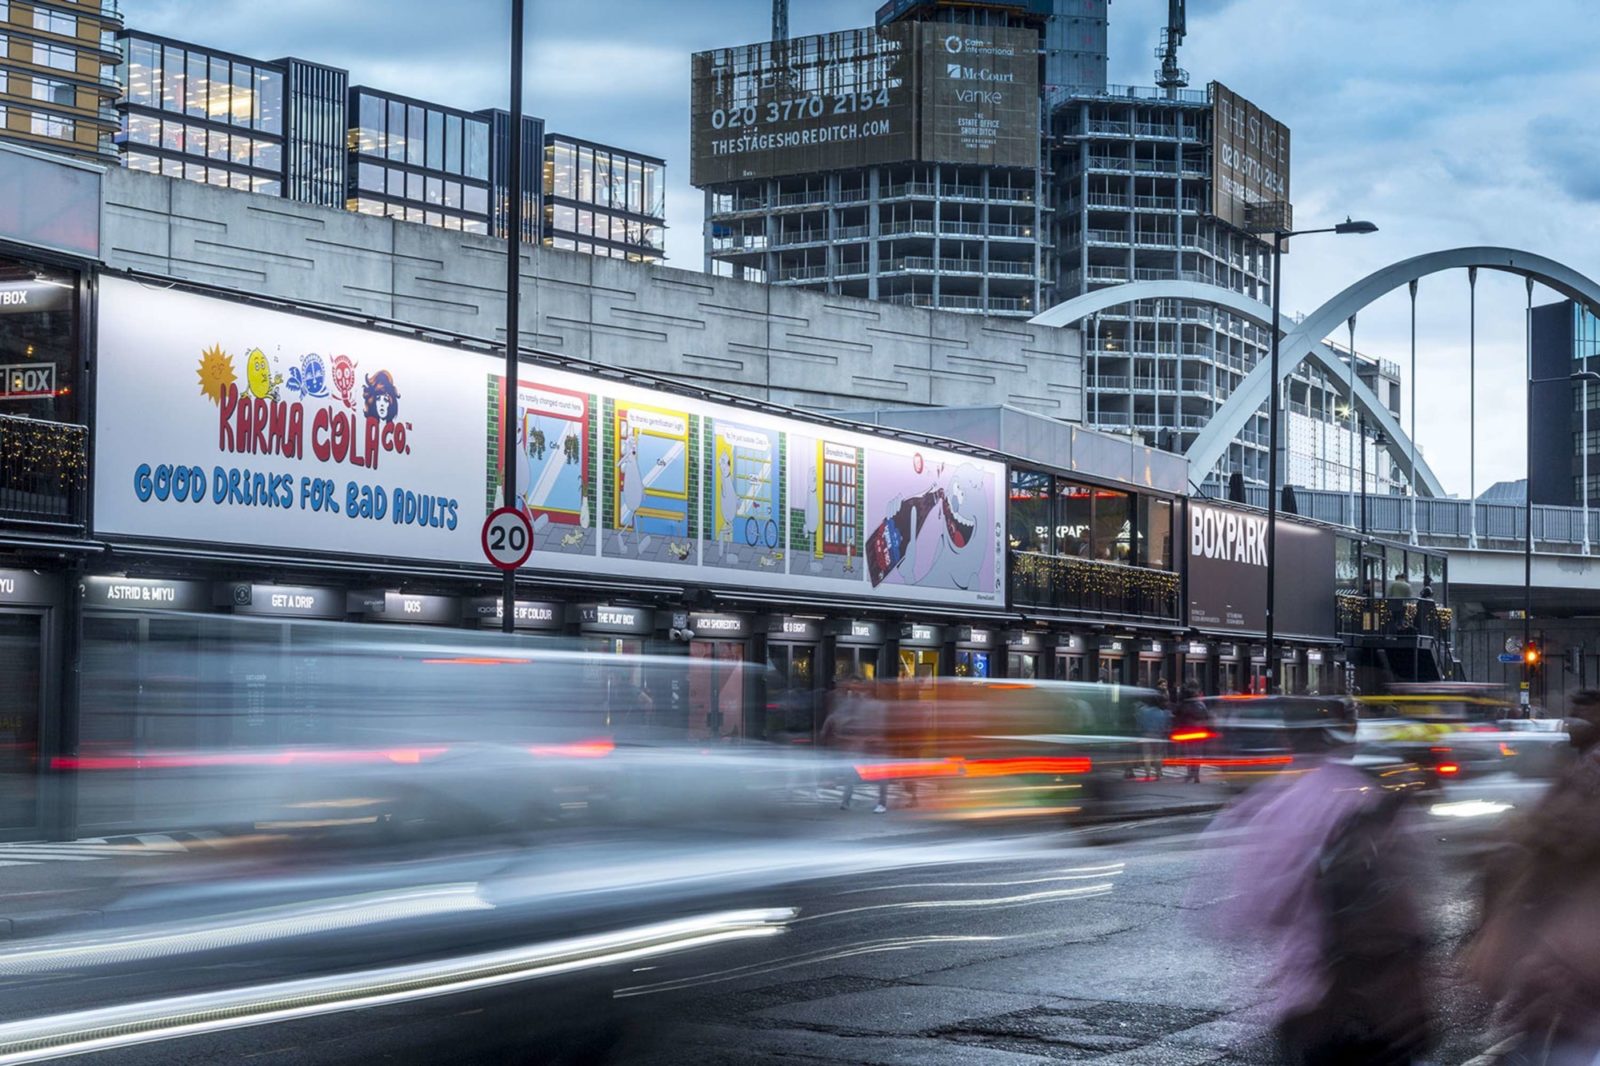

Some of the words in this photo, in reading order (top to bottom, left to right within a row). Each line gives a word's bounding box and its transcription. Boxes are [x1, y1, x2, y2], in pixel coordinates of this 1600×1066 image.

[963, 67, 1014, 82] McCourt
[712, 106, 757, 129] 020
[766, 95, 824, 122] 3770
[833, 89, 890, 114] 2154
[955, 89, 1002, 104] vanke
[711, 119, 890, 155] THESTAGESHOREDITCH.COM
[1222, 99, 1245, 140] THE
[1249, 116, 1285, 164] STAGE
[1222, 143, 1240, 170] 020
[1242, 155, 1263, 183] 3770
[1264, 169, 1284, 196] 2154
[11, 370, 49, 392] BOX
[218, 382, 303, 460] KARMA
[312, 405, 380, 470] COLA
[134, 463, 207, 502] GOOD
[300, 476, 340, 513] FOR
[392, 487, 458, 531] ADULTS
[490, 525, 526, 550] 20
[1191, 507, 1268, 567] BOXPARK
[107, 585, 141, 599] ASTRID
[142, 588, 150, 600] &
[152, 587, 175, 601] MIYU
[271, 594, 288, 608] GET
[288, 594, 295, 608] A
[295, 594, 314, 608] DRIP
[404, 600, 421, 613] IQOS
[519, 607, 528, 618] OF
[528, 608, 553, 621] COLOUR
